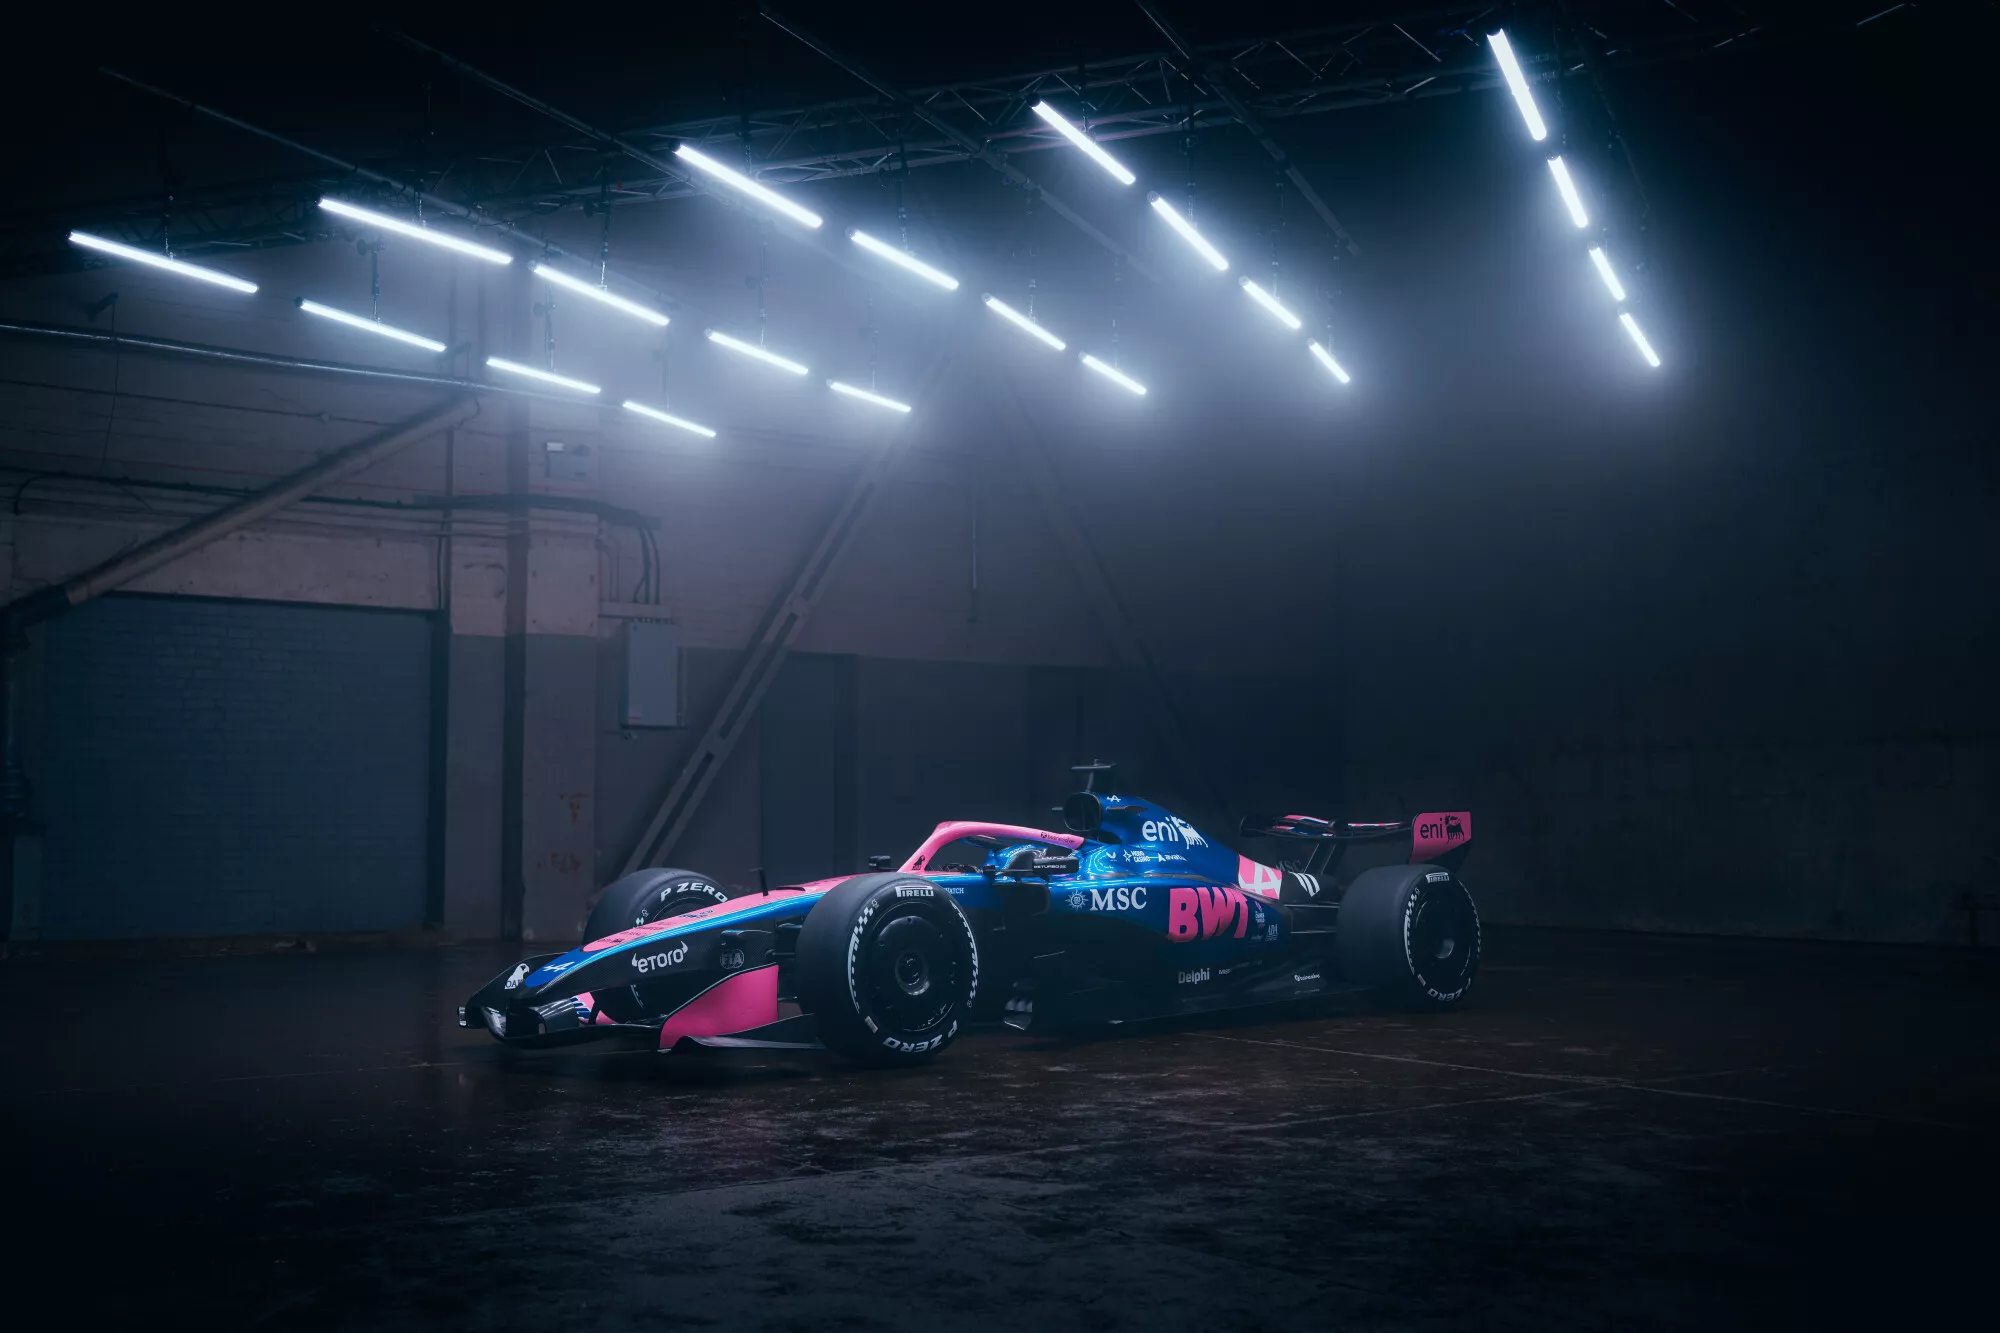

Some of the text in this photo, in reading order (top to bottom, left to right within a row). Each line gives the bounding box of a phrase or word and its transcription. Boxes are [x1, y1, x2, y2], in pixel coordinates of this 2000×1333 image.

[1141, 816, 1179, 842] eni
[1420, 817, 1443, 839] eni
[1425, 871, 1450, 884] PIRELLI
[660, 882, 728, 903] P ZERO
[894, 884, 935, 898] PIRELLI
[1089, 886, 1147, 911] MSC
[1167, 886, 1249, 943] BWT
[721, 952, 743, 966] FIA
[1178, 967, 1210, 984] Delphi
[1427, 987, 1463, 1001] ZERO
[882, 1019, 958, 1053] P ZERO
